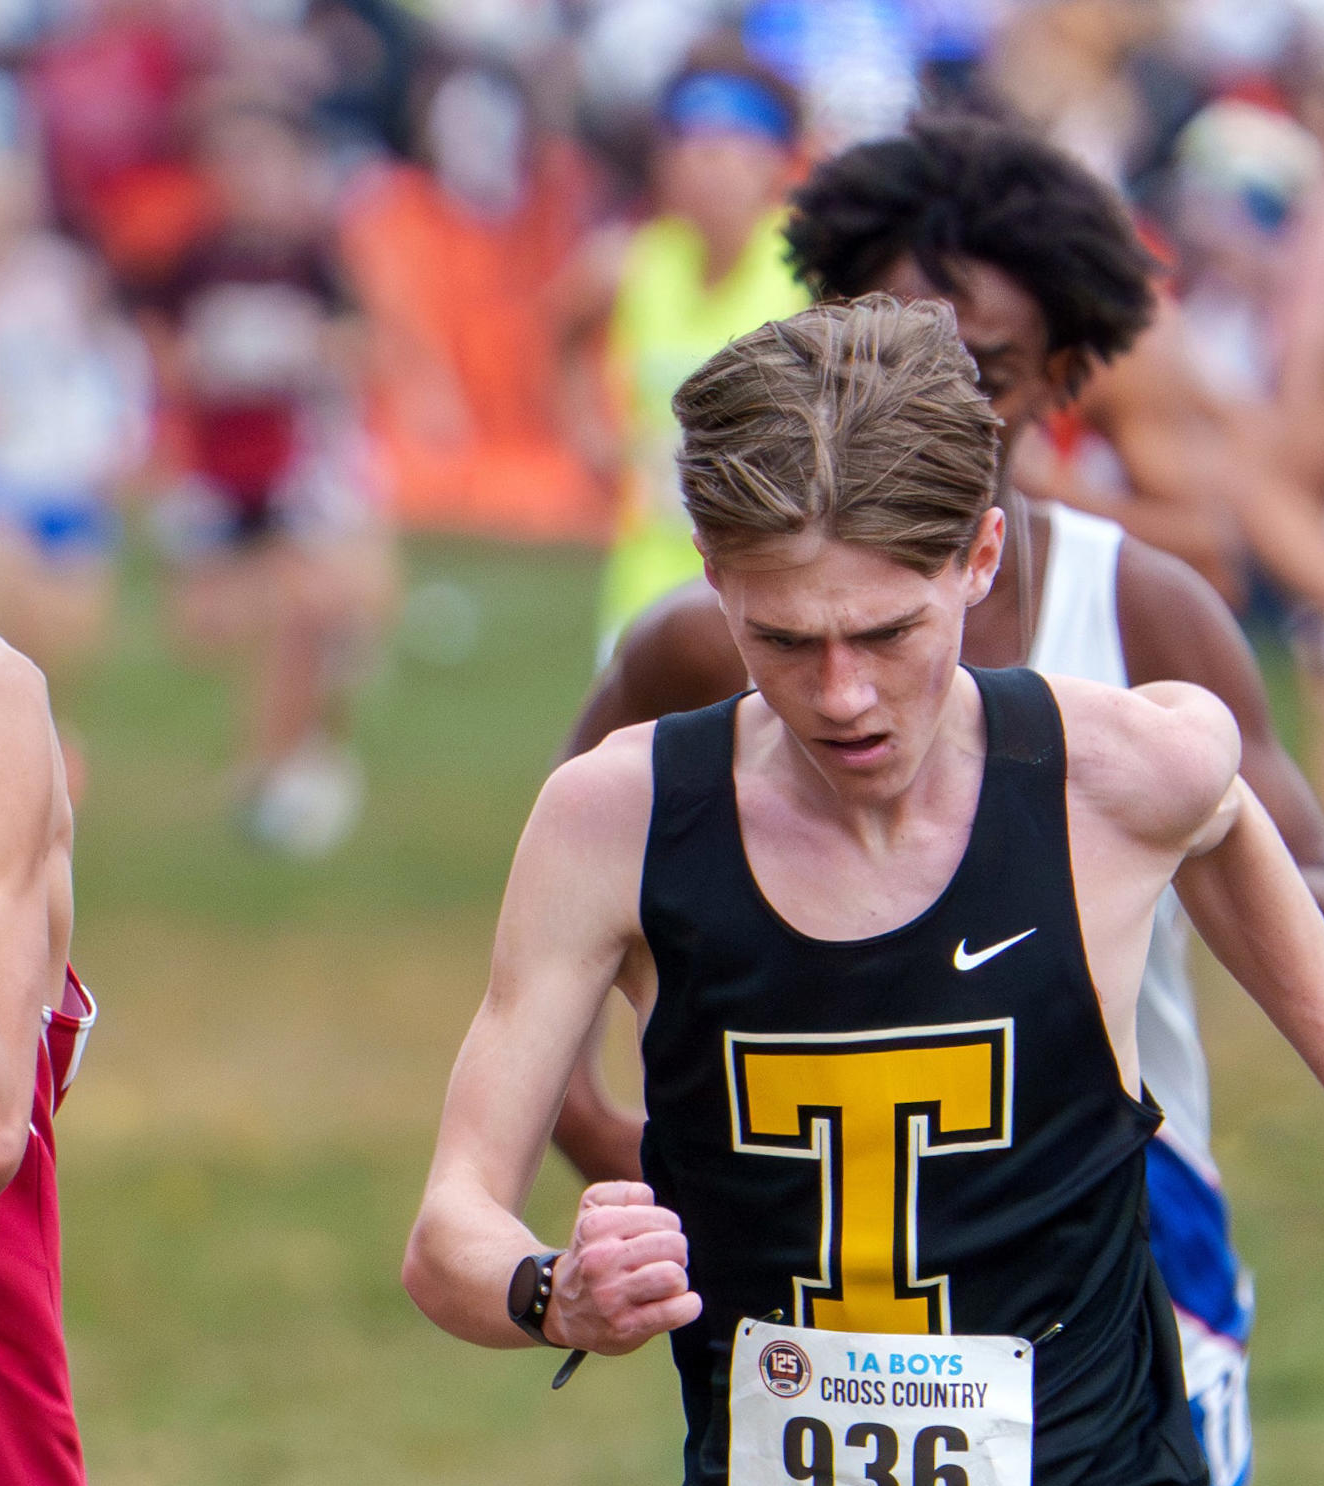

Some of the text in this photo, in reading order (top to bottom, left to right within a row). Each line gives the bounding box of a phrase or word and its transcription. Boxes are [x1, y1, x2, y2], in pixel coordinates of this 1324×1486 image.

[724, 1016, 1015, 1335] T
[771, 1351, 798, 1375] 125
[846, 1351, 964, 1377] 1A BOYS
[820, 1376, 988, 1409] CROSS COUNTRY
